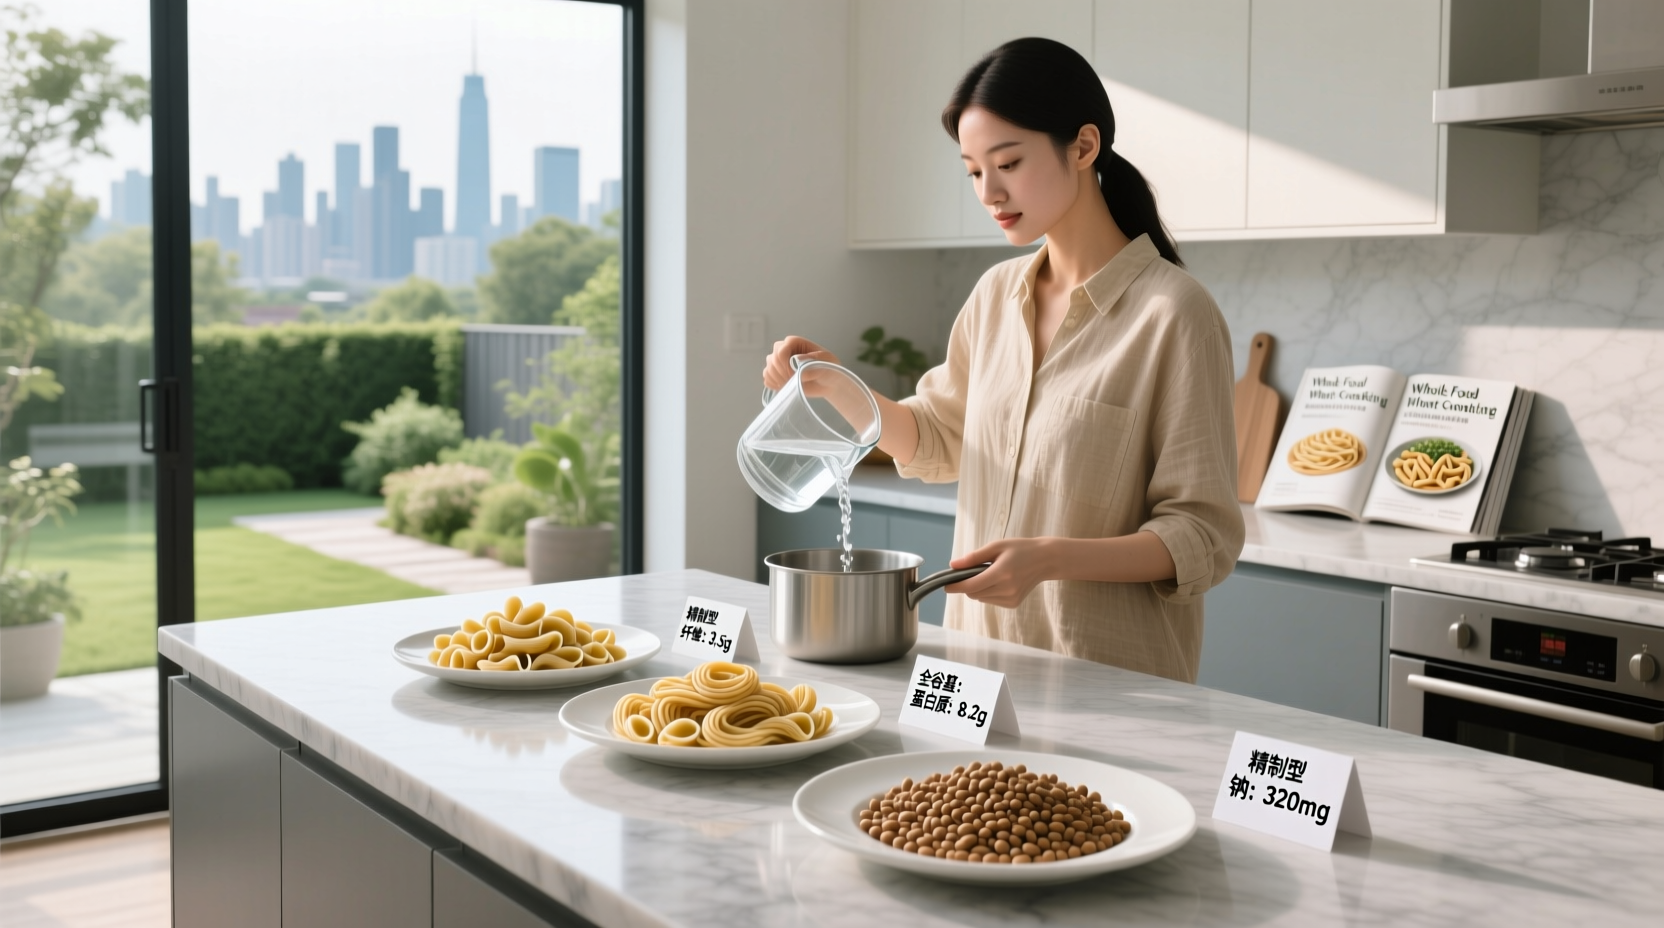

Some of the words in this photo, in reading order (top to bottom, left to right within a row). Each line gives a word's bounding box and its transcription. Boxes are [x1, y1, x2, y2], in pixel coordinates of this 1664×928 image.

[1248, 749, 1308, 784] 精制型
[1262, 785, 1331, 826] 320mg
